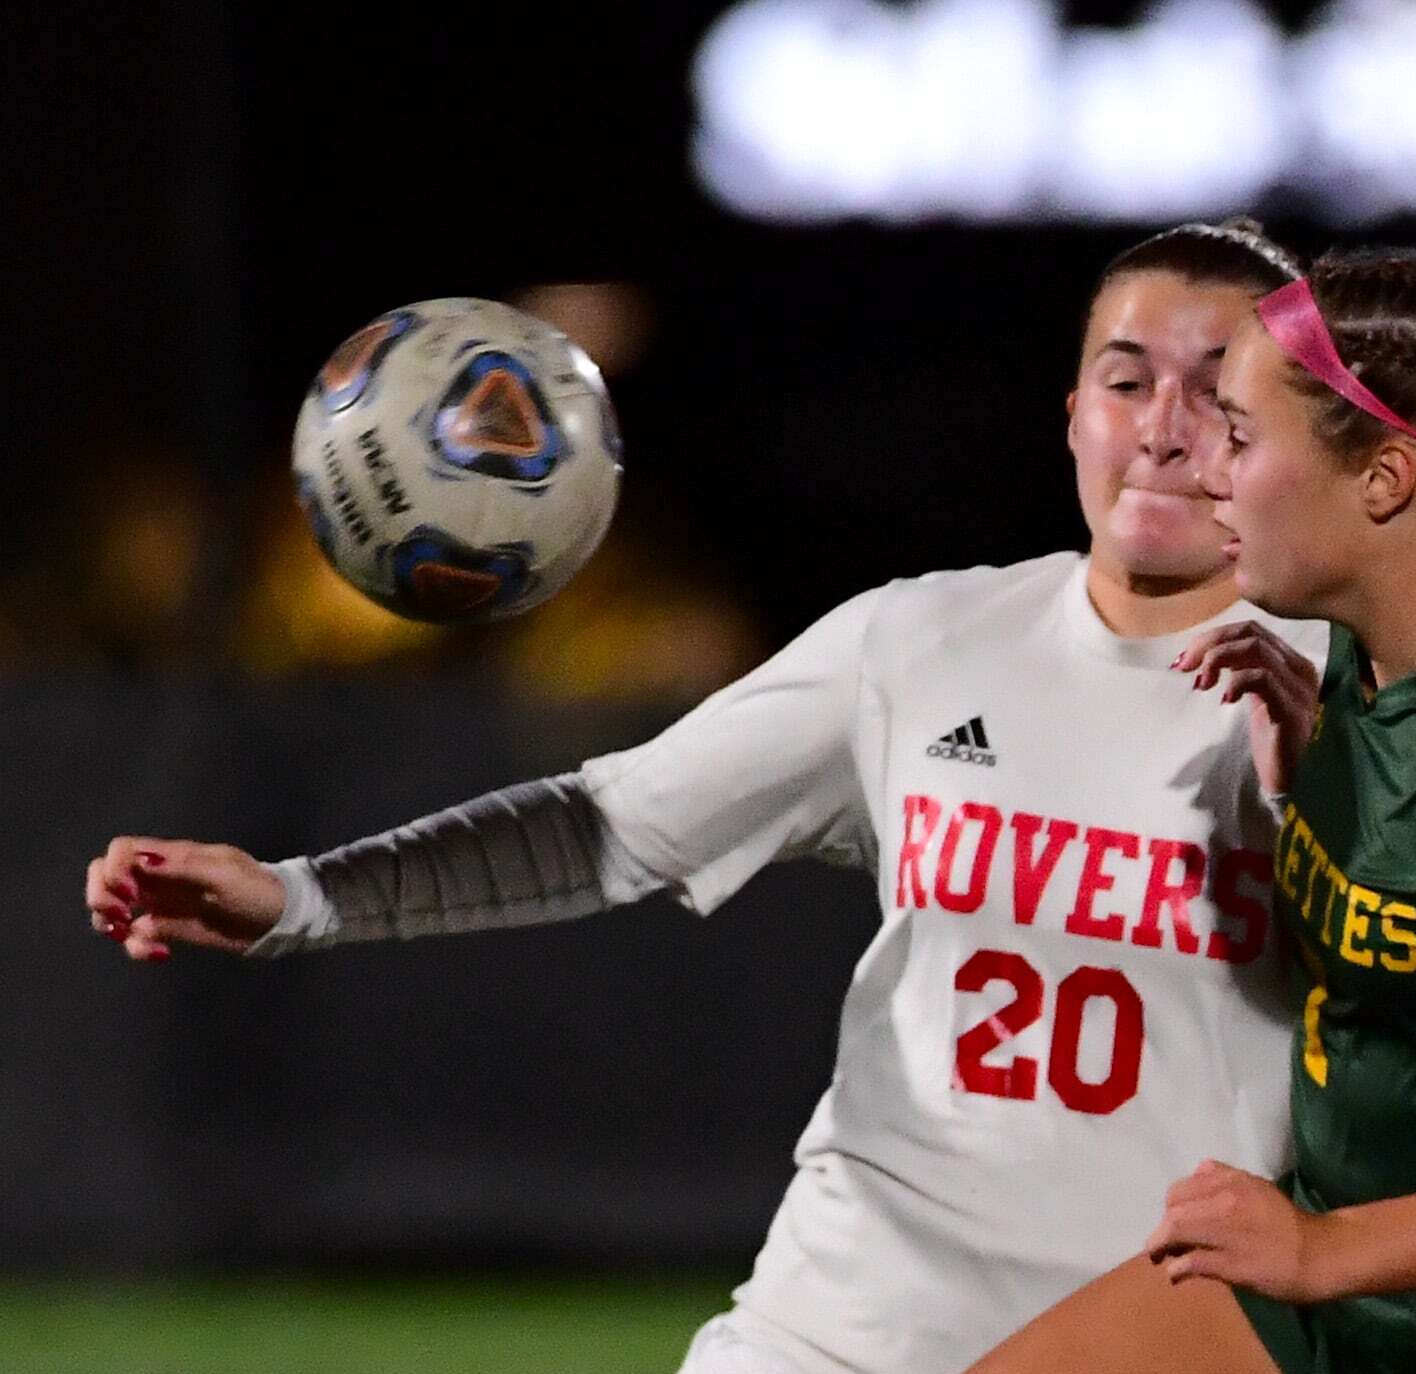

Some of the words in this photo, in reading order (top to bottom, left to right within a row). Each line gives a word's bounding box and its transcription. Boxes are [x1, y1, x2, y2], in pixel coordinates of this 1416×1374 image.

[926, 742, 997, 768] adidas
[897, 795, 1275, 965] ROVERS
[952, 949, 1145, 1115] 20
